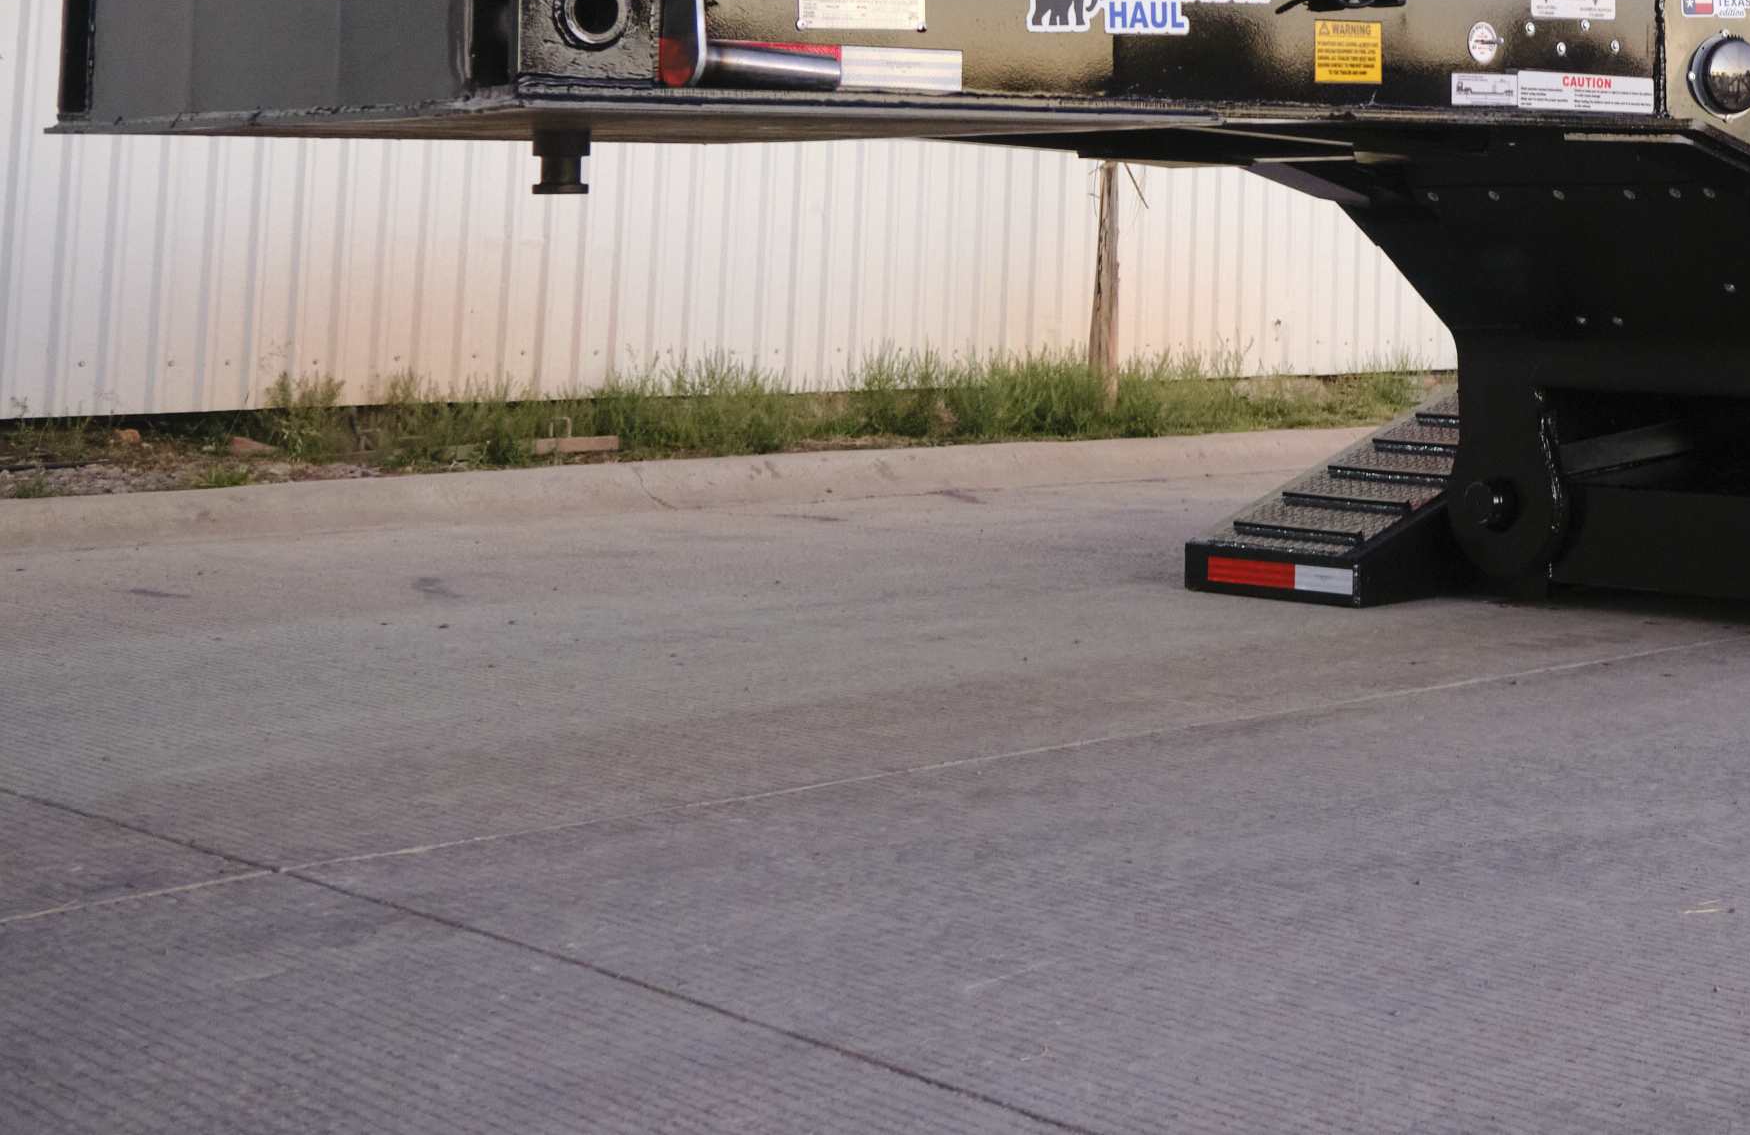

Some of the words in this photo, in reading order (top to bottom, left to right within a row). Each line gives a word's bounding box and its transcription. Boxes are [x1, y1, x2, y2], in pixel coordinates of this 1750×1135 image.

[1109, 1, 1185, 29] HAUL
[1719, 8, 1745, 17] edition
[1332, 23, 1371, 36] WARNING
[1562, 76, 1612, 89] CAUTION
